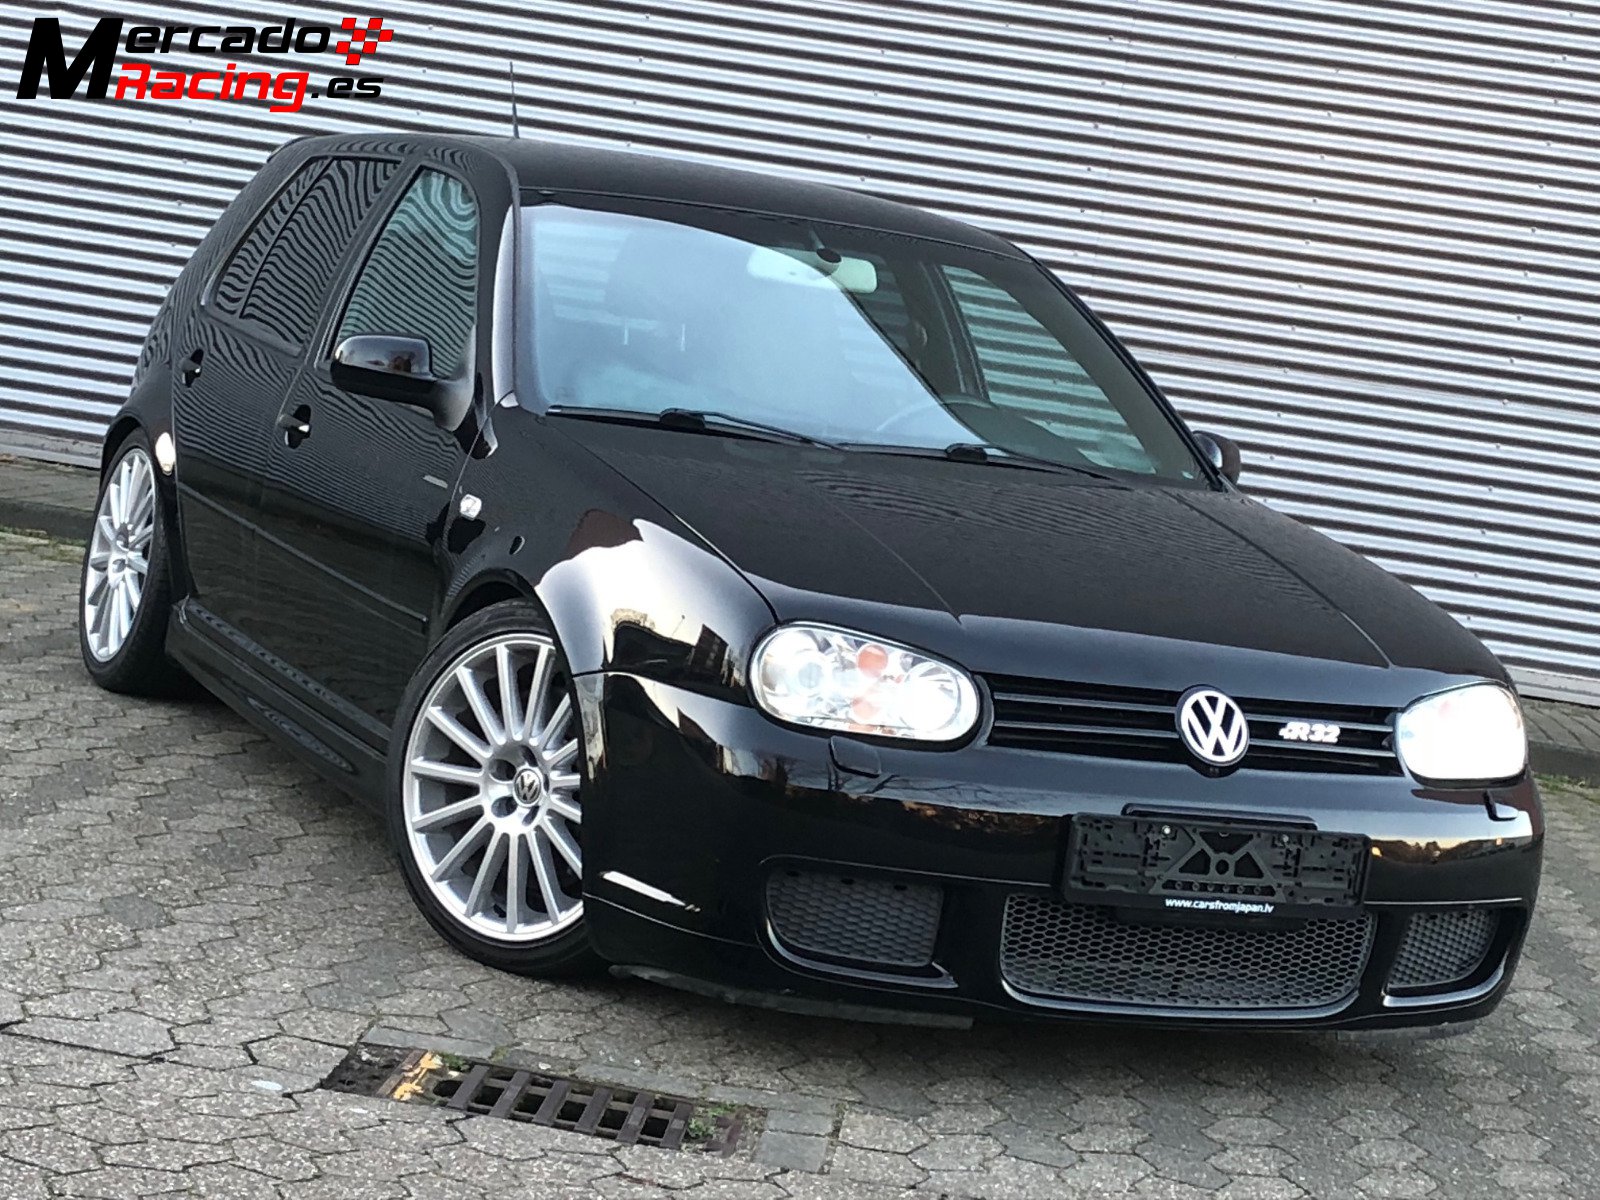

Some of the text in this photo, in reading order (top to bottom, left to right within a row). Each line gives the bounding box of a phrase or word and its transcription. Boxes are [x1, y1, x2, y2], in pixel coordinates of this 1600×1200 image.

[1181, 690, 1248, 762] VW
[1279, 722, 1340, 743] R32
[1165, 898, 1274, 914] www.carsfromjapan.lv
